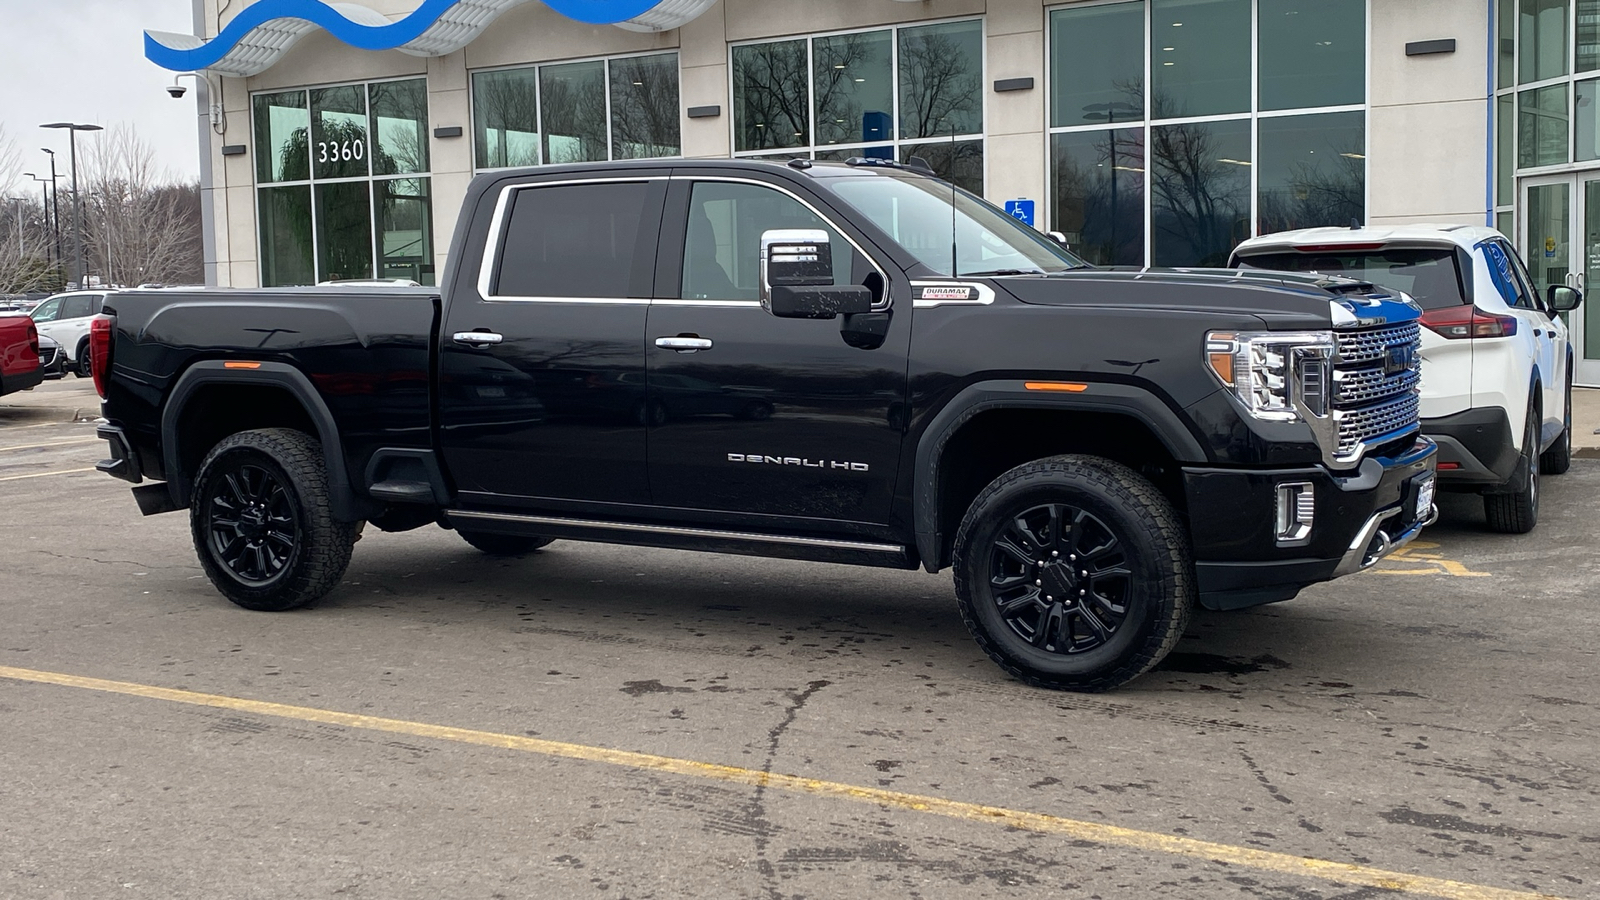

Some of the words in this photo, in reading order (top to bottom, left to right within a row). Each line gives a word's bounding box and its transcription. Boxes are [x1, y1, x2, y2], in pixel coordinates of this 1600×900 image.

[318, 139, 364, 163] 3360
[727, 453, 825, 468] DENALI
[830, 460, 869, 472] HD
